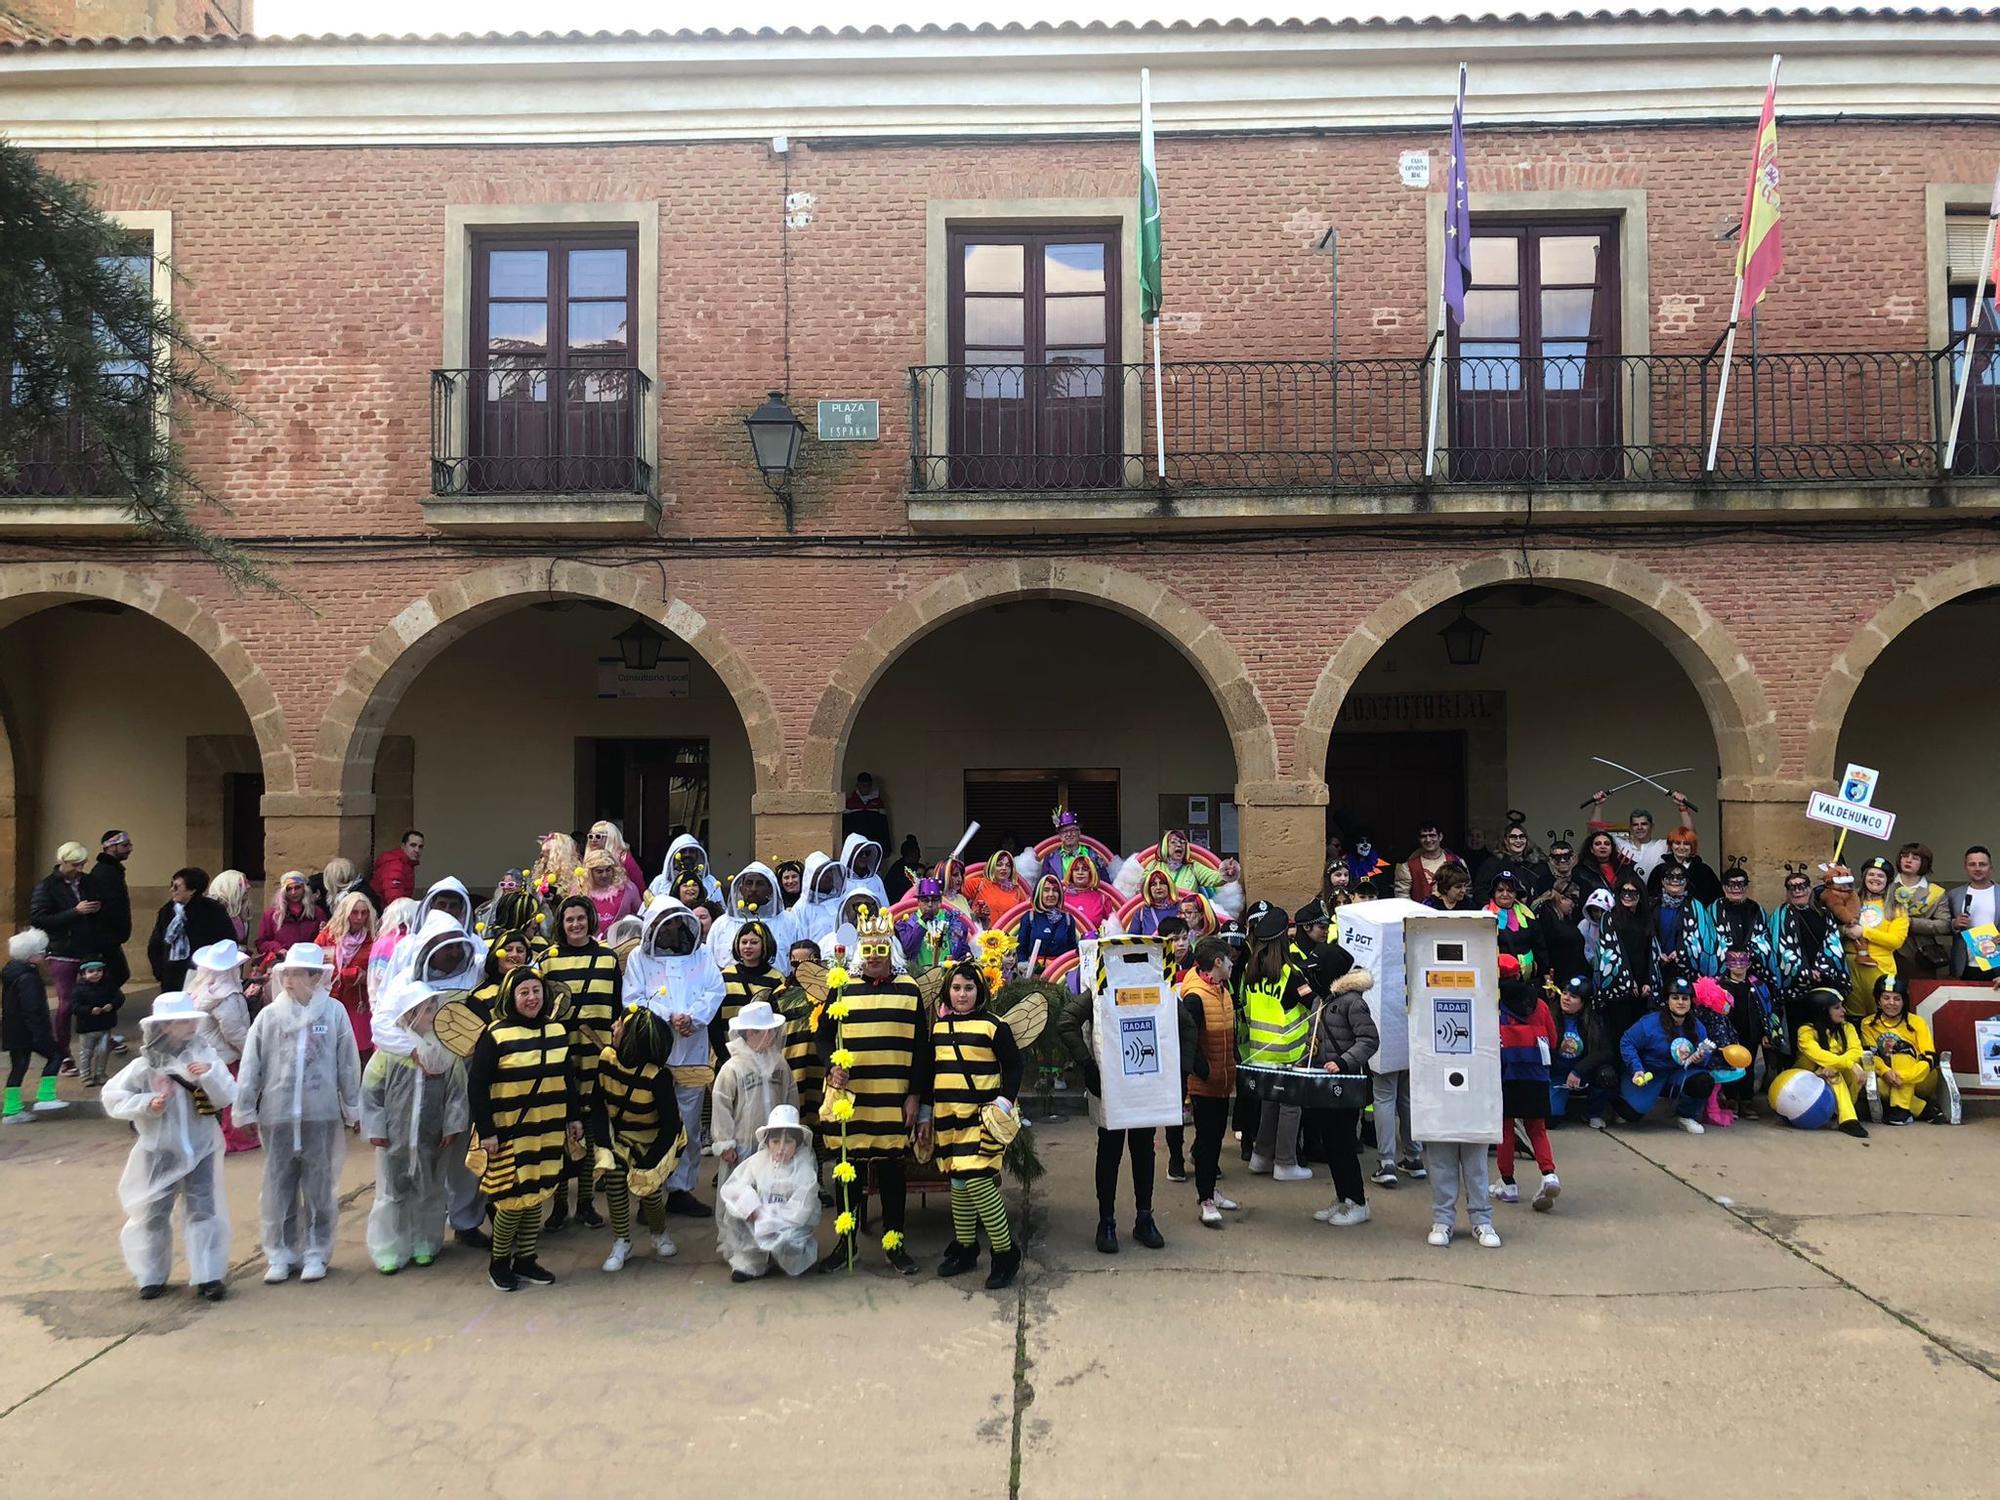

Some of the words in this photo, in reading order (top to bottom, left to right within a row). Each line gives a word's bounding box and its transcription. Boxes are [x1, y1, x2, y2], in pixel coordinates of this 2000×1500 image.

[831, 403, 865, 413] PLAZA
[844, 414, 852, 425] DE
[1818, 801, 1882, 829] VALDEHUNCO
[1436, 1003, 1467, 1012] RADAR
[1123, 1021, 1152, 1031] RADAR
